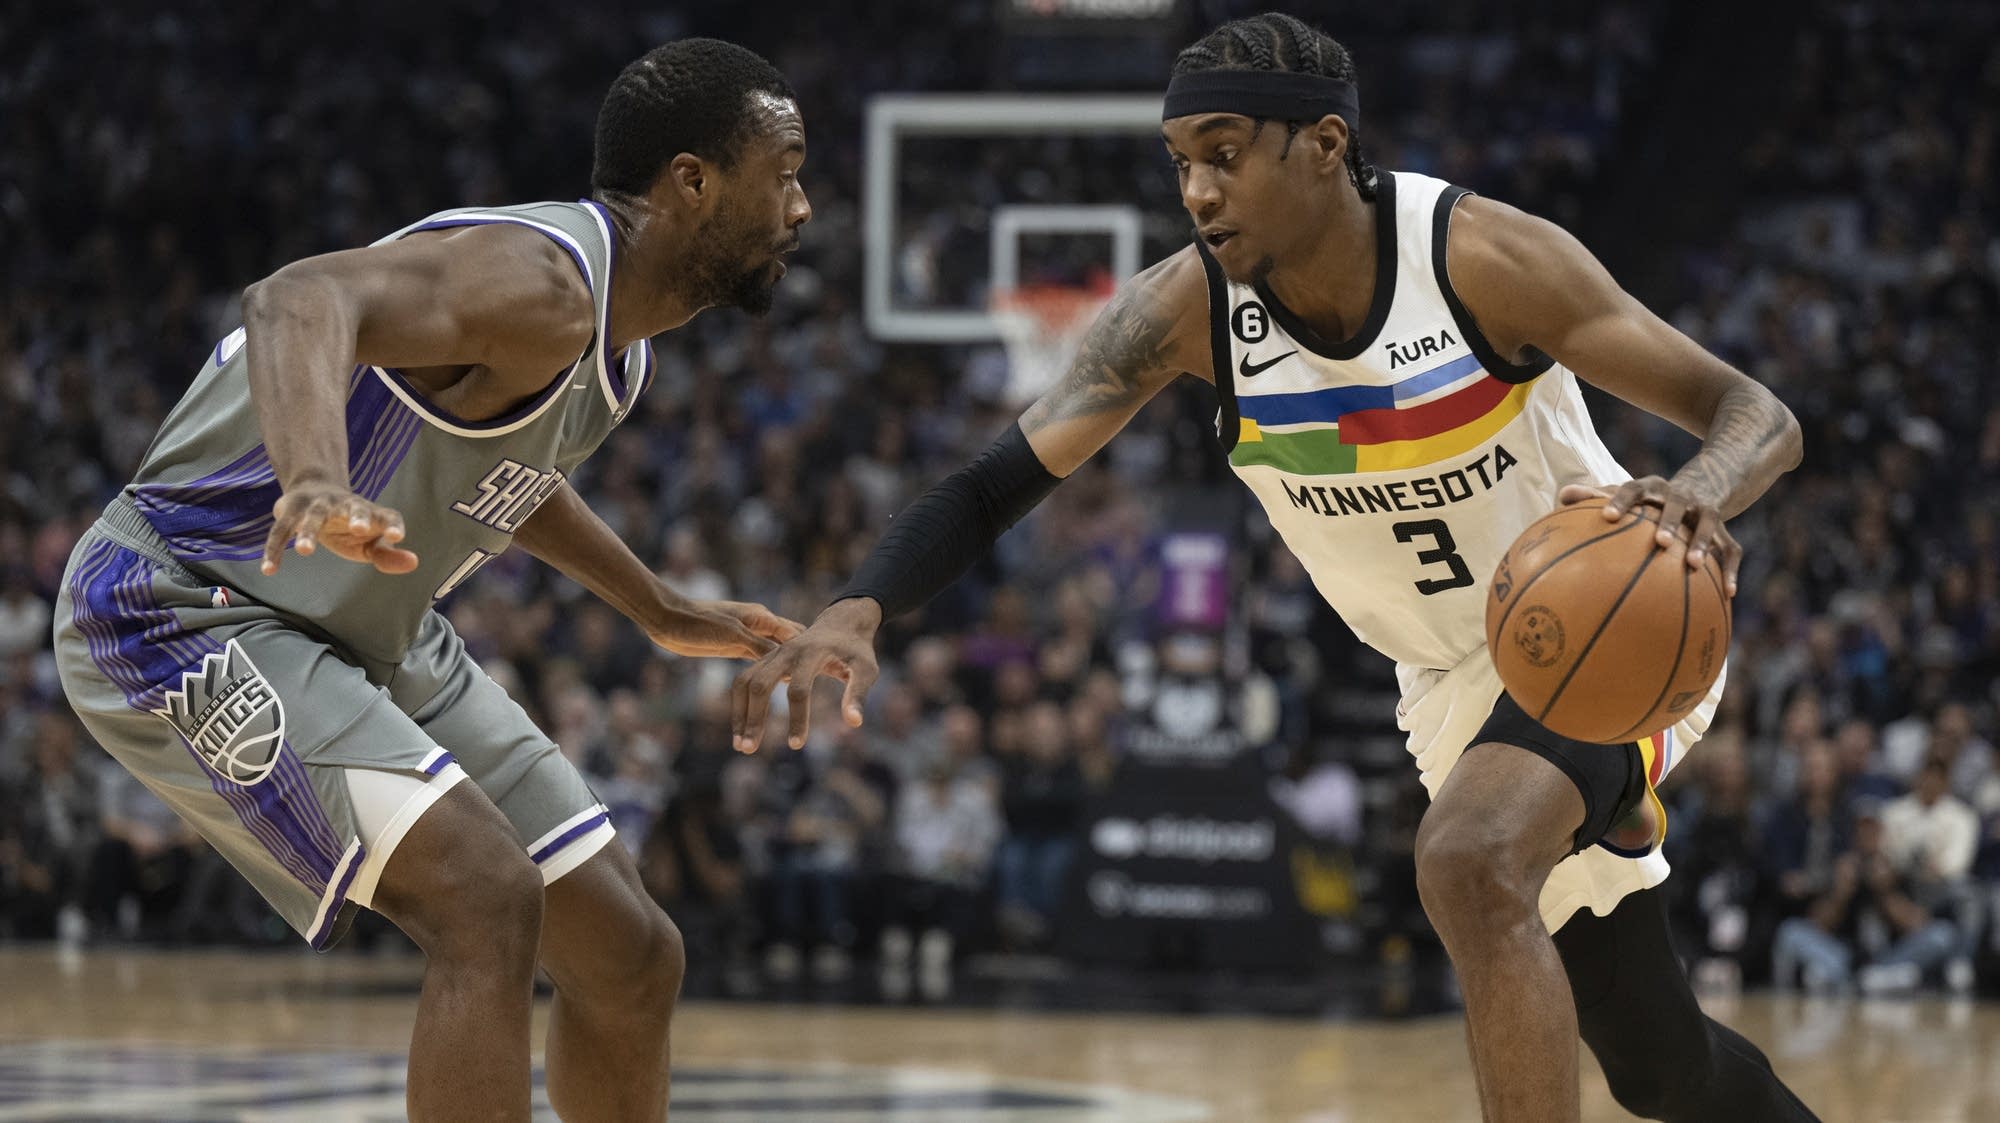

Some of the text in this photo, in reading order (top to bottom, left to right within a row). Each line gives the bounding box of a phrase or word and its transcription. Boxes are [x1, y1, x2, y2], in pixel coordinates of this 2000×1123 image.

[1241, 307, 1262, 342] 6
[1280, 443, 1518, 516] MINNESOTA
[1392, 518, 1475, 596] 3
[186, 671, 257, 742] SACRAMENTO
[195, 679, 274, 764] KINGS
